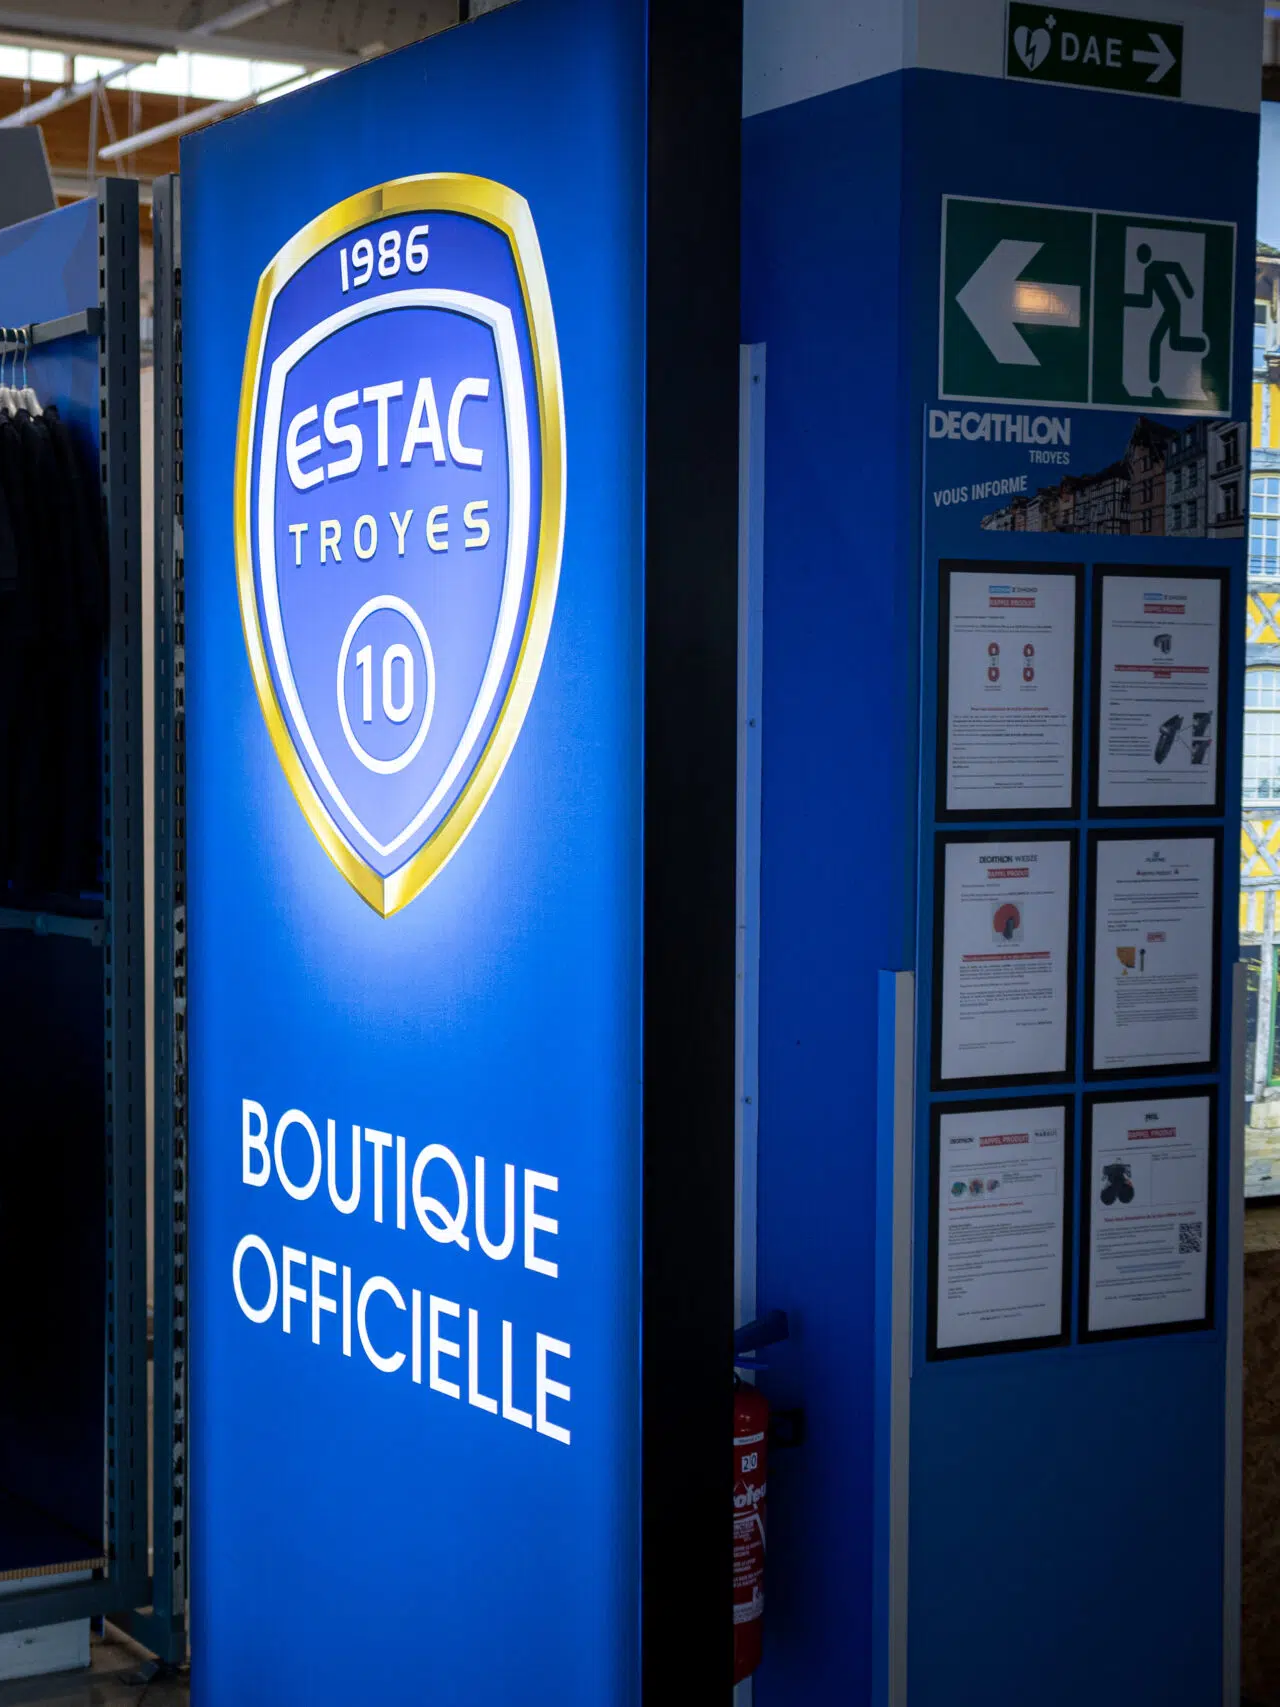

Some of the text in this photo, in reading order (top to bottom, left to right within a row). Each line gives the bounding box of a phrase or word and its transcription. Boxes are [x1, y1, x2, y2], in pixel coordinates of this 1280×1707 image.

[1061, 32, 1123, 69] DAE
[339, 223, 431, 294] 1986
[286, 377, 490, 491] ESTAC
[928, 409, 1072, 447] DECATHLON
[1028, 449, 1071, 466] TROYES
[933, 475, 1028, 508] VOUS INFORME
[287, 498, 491, 567] TROYES
[354, 642, 416, 725] 10
[241, 1098, 559, 1279] BOUTIQUE
[231, 1233, 571, 1446] OFFICIELLE
